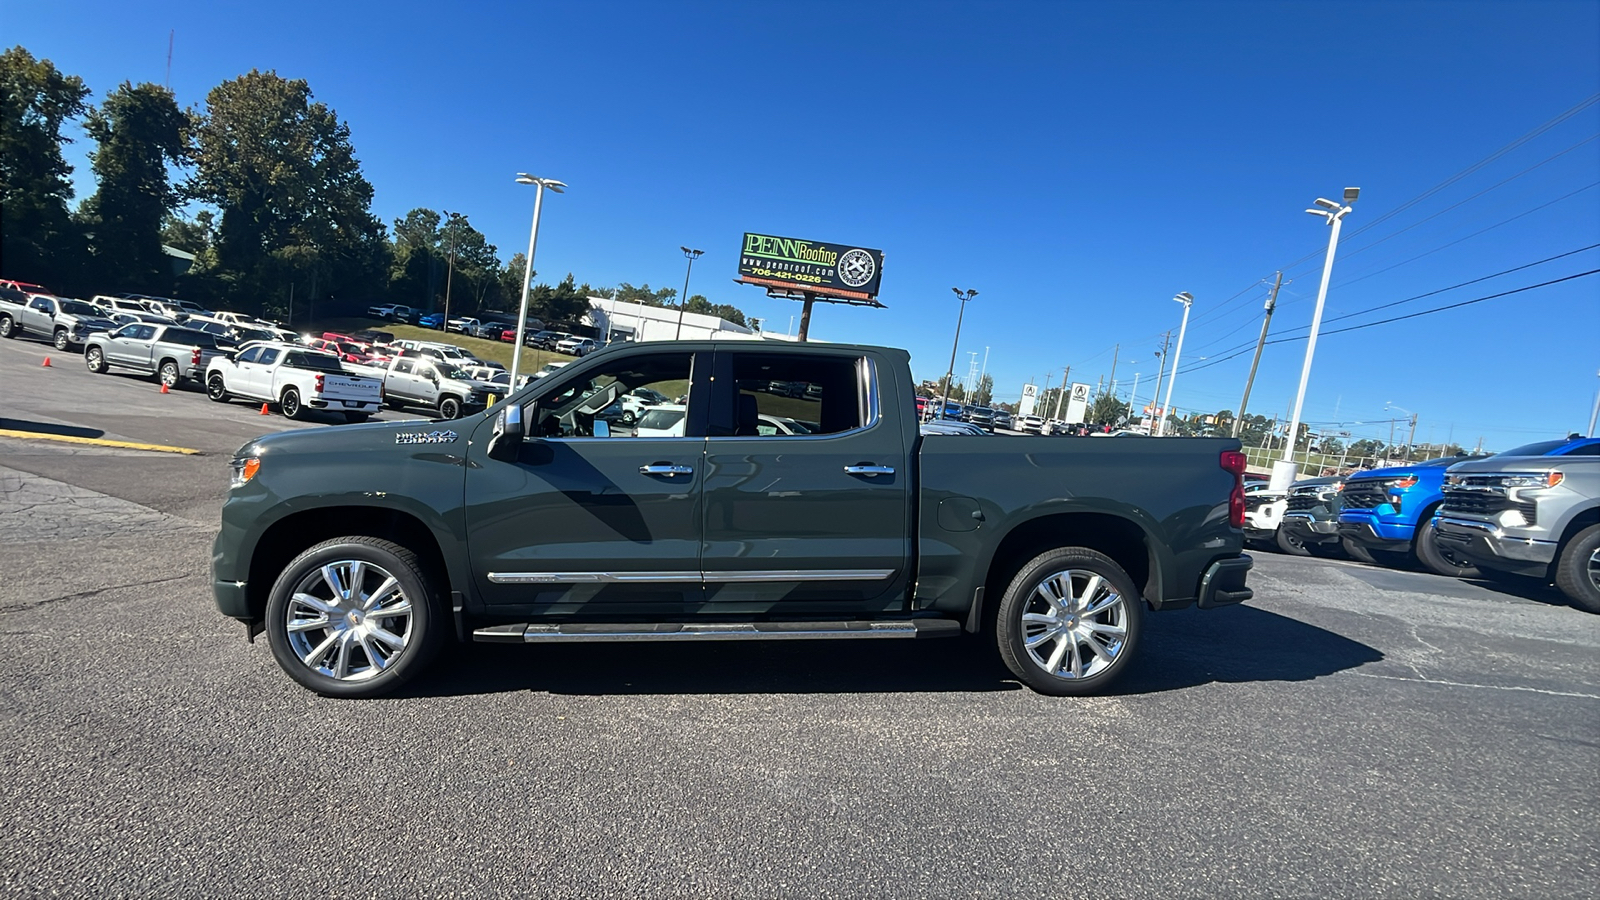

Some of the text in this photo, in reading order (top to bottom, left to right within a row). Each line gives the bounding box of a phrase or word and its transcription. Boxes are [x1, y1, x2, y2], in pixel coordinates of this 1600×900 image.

[744, 234, 838, 267] PENN Roofing
[742, 257, 834, 277] www.pennroof.com
[751, 267, 822, 284] 706-421-0226
[328, 381, 379, 390] CHEVROLET
